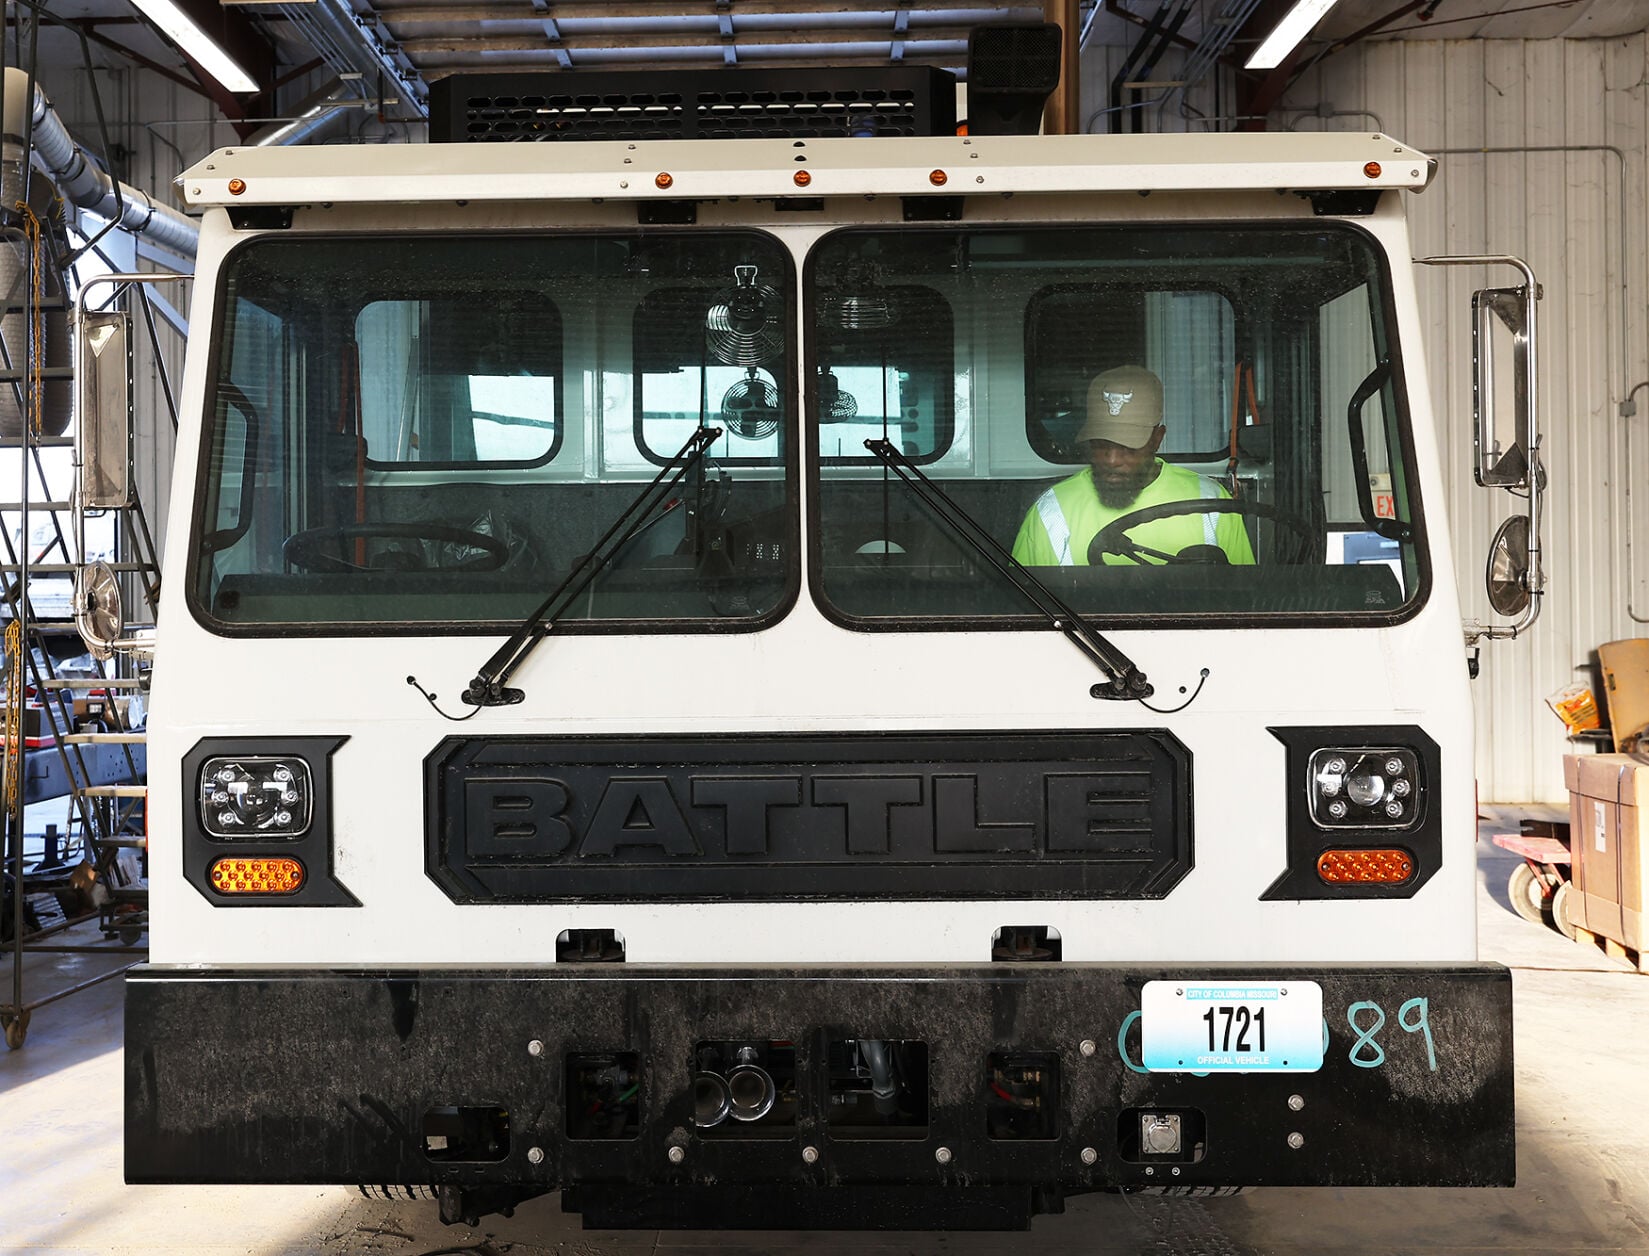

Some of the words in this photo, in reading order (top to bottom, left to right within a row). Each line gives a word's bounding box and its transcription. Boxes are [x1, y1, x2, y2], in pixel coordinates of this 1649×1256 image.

[465, 772, 1153, 856] BATTLE
[1203, 1006, 1265, 1052] 1721
[1197, 1056, 1233, 1065] OFFICIAL
[1235, 1056, 1269, 1065] VEHICLE
